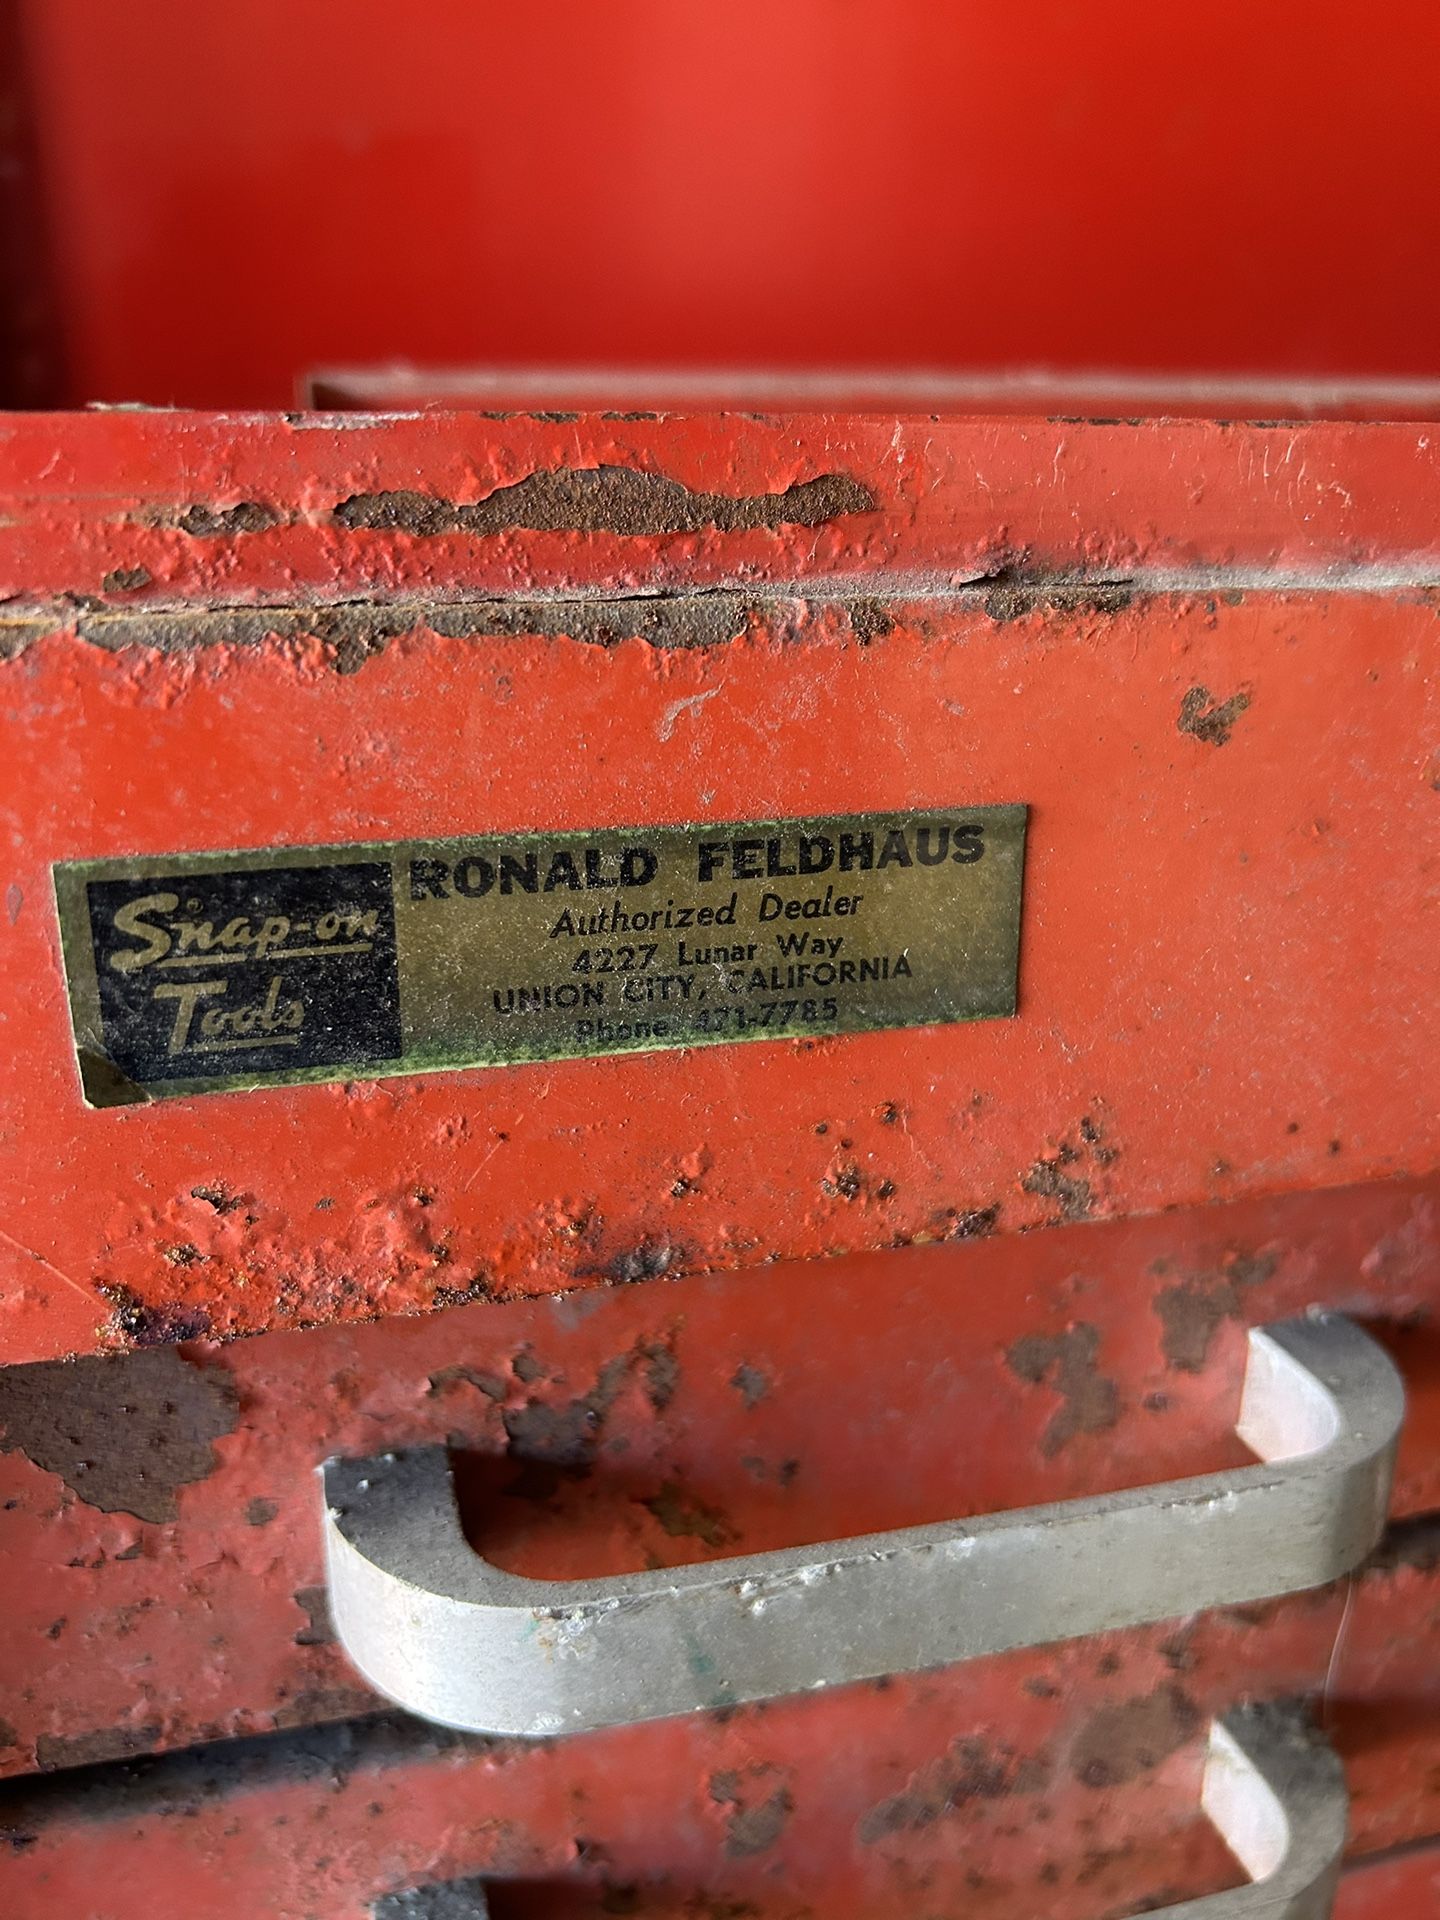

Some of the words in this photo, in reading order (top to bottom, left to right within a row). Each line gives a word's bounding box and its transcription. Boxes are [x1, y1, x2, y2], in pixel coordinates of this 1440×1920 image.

[409, 847, 659, 901] RONALD
[697, 824, 986, 883] FELDHAUS
[109, 891, 379, 973] Snap-on
[550, 892, 738, 939] Authorized
[758, 885, 865, 923] Dealer
[492, 981, 605, 1014] UNION
[728, 954, 913, 995] CALIFORNIA
[571, 943, 660, 975] 4227
[678, 940, 758, 968] Lunar
[776, 932, 844, 959] Way
[152, 975, 306, 1054] Tools
